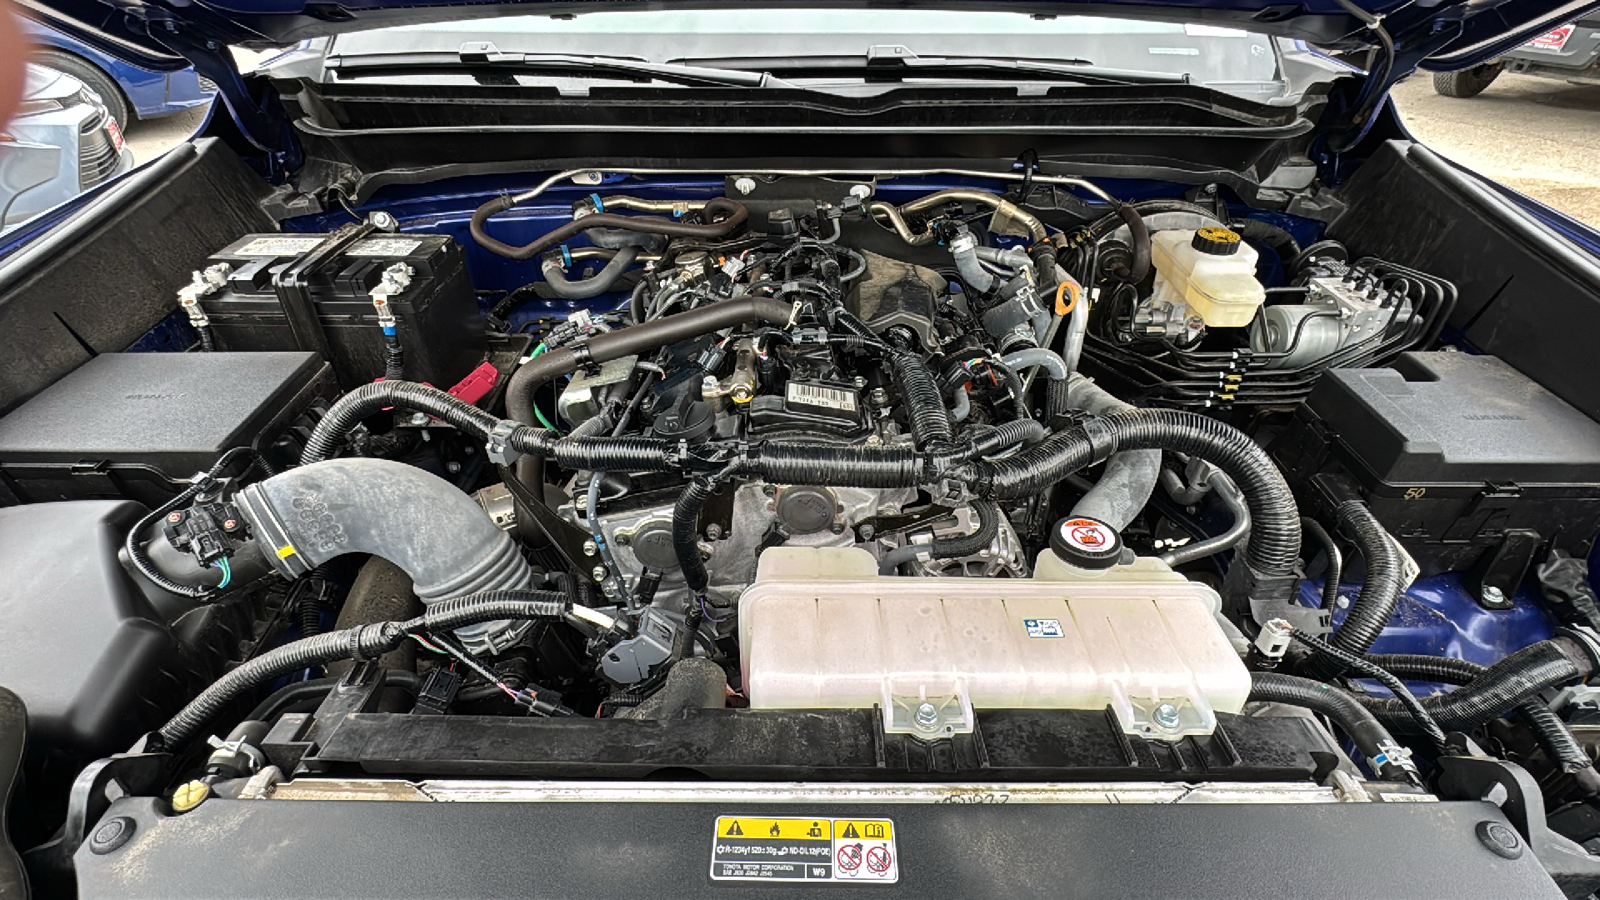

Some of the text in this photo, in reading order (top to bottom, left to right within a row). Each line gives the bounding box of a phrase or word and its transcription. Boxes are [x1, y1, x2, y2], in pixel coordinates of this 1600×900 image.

[1403, 487, 1426, 501] 50
[725, 845, 750, 856] R-1234yf
[761, 865, 794, 873] CORPORATION
[812, 868, 826, 877] W9
